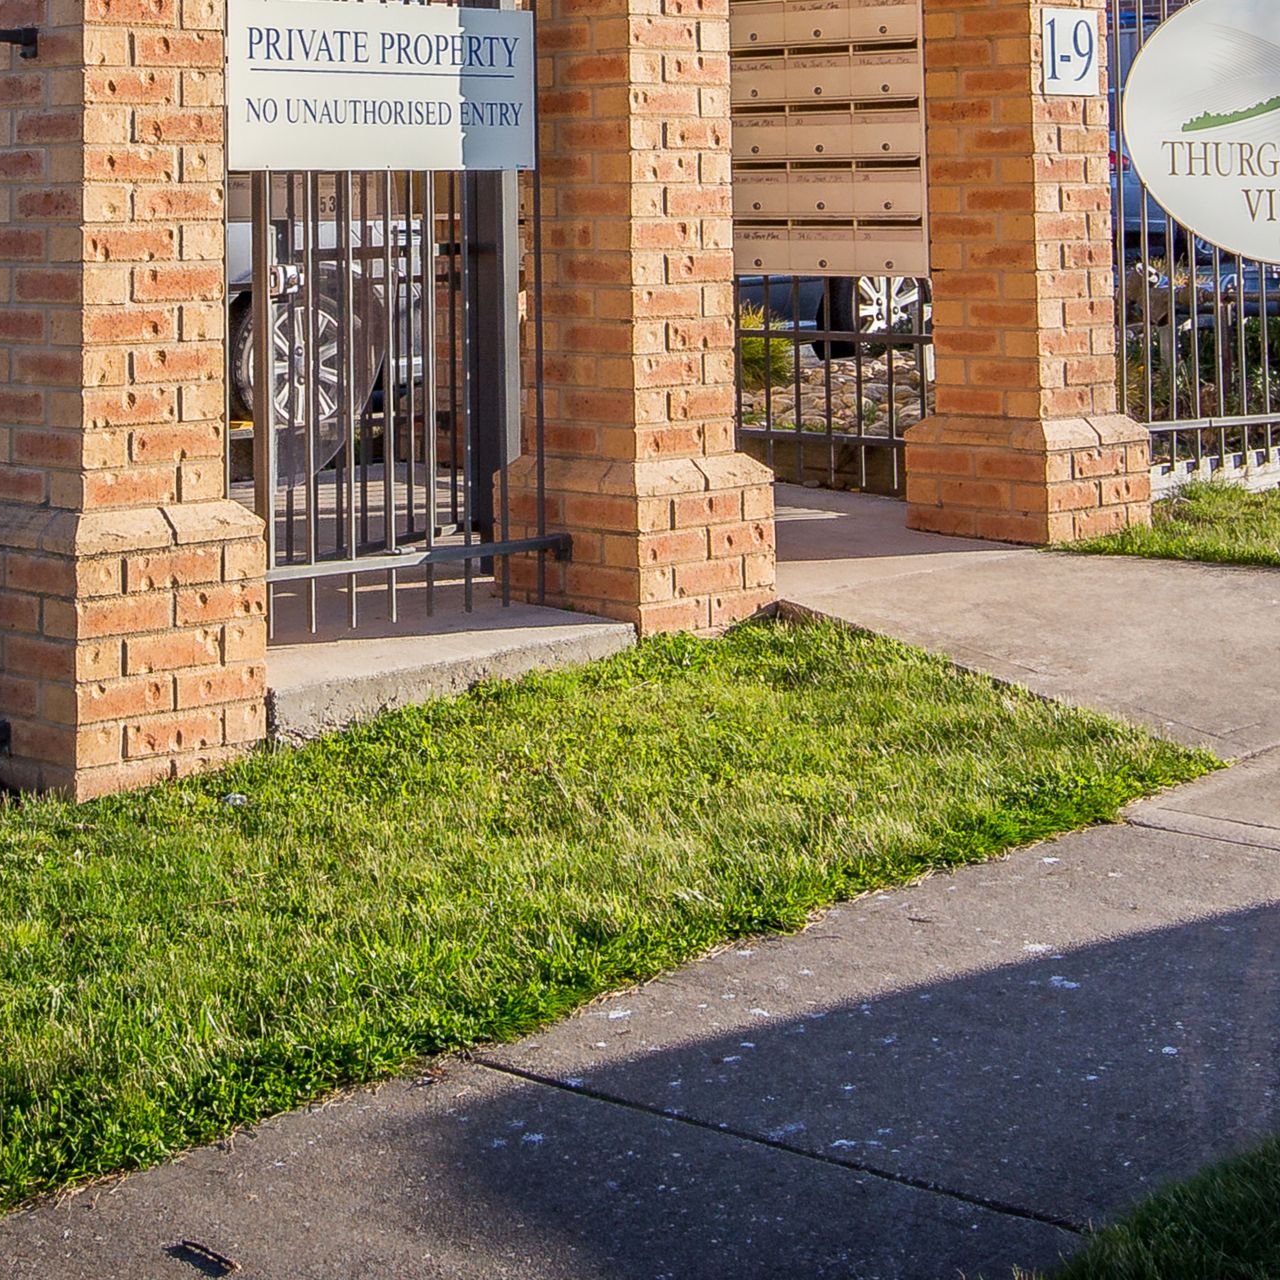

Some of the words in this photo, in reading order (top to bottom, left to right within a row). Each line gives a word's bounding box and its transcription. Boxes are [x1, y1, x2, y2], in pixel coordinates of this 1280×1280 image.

[246, 26, 370, 64] PRIVATE
[379, 32, 521, 69] PROPERTY
[1045, 16, 1094, 82] 1-9
[246, 97, 278, 124] NO
[285, 98, 453, 126] UNAUTHORISED
[460, 101, 524, 127] ENTRY
